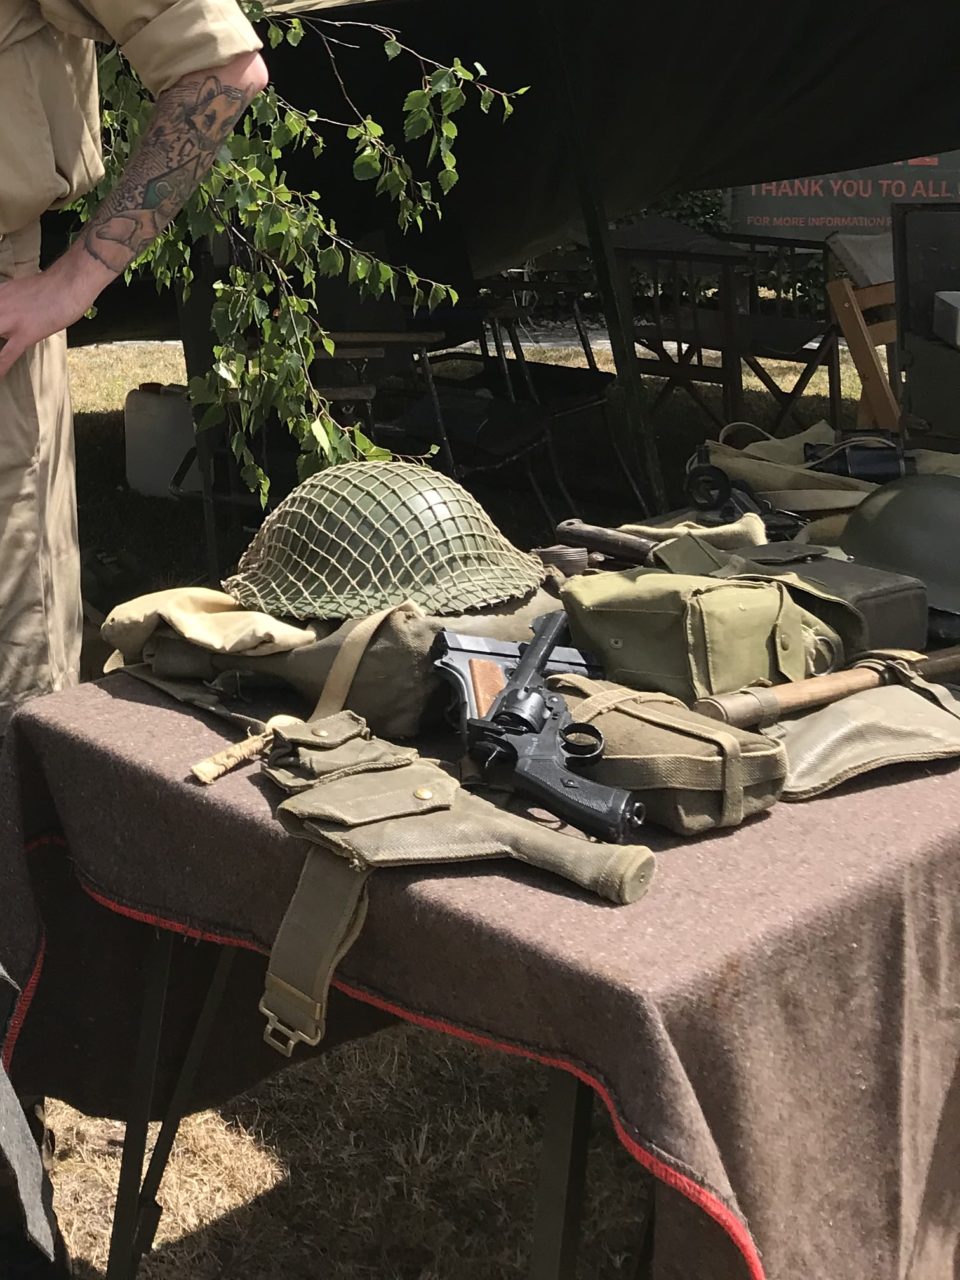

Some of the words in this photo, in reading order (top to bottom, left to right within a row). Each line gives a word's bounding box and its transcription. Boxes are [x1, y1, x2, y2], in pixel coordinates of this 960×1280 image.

[751, 179, 824, 197] THANK
[830, 179, 872, 198] YOU
[878, 179, 907, 198] TO
[911, 179, 951, 198] ALL
[746, 216, 770, 225] FOR
[772, 216, 805, 227] MORE
[807, 216, 884, 227] INFORMATION
